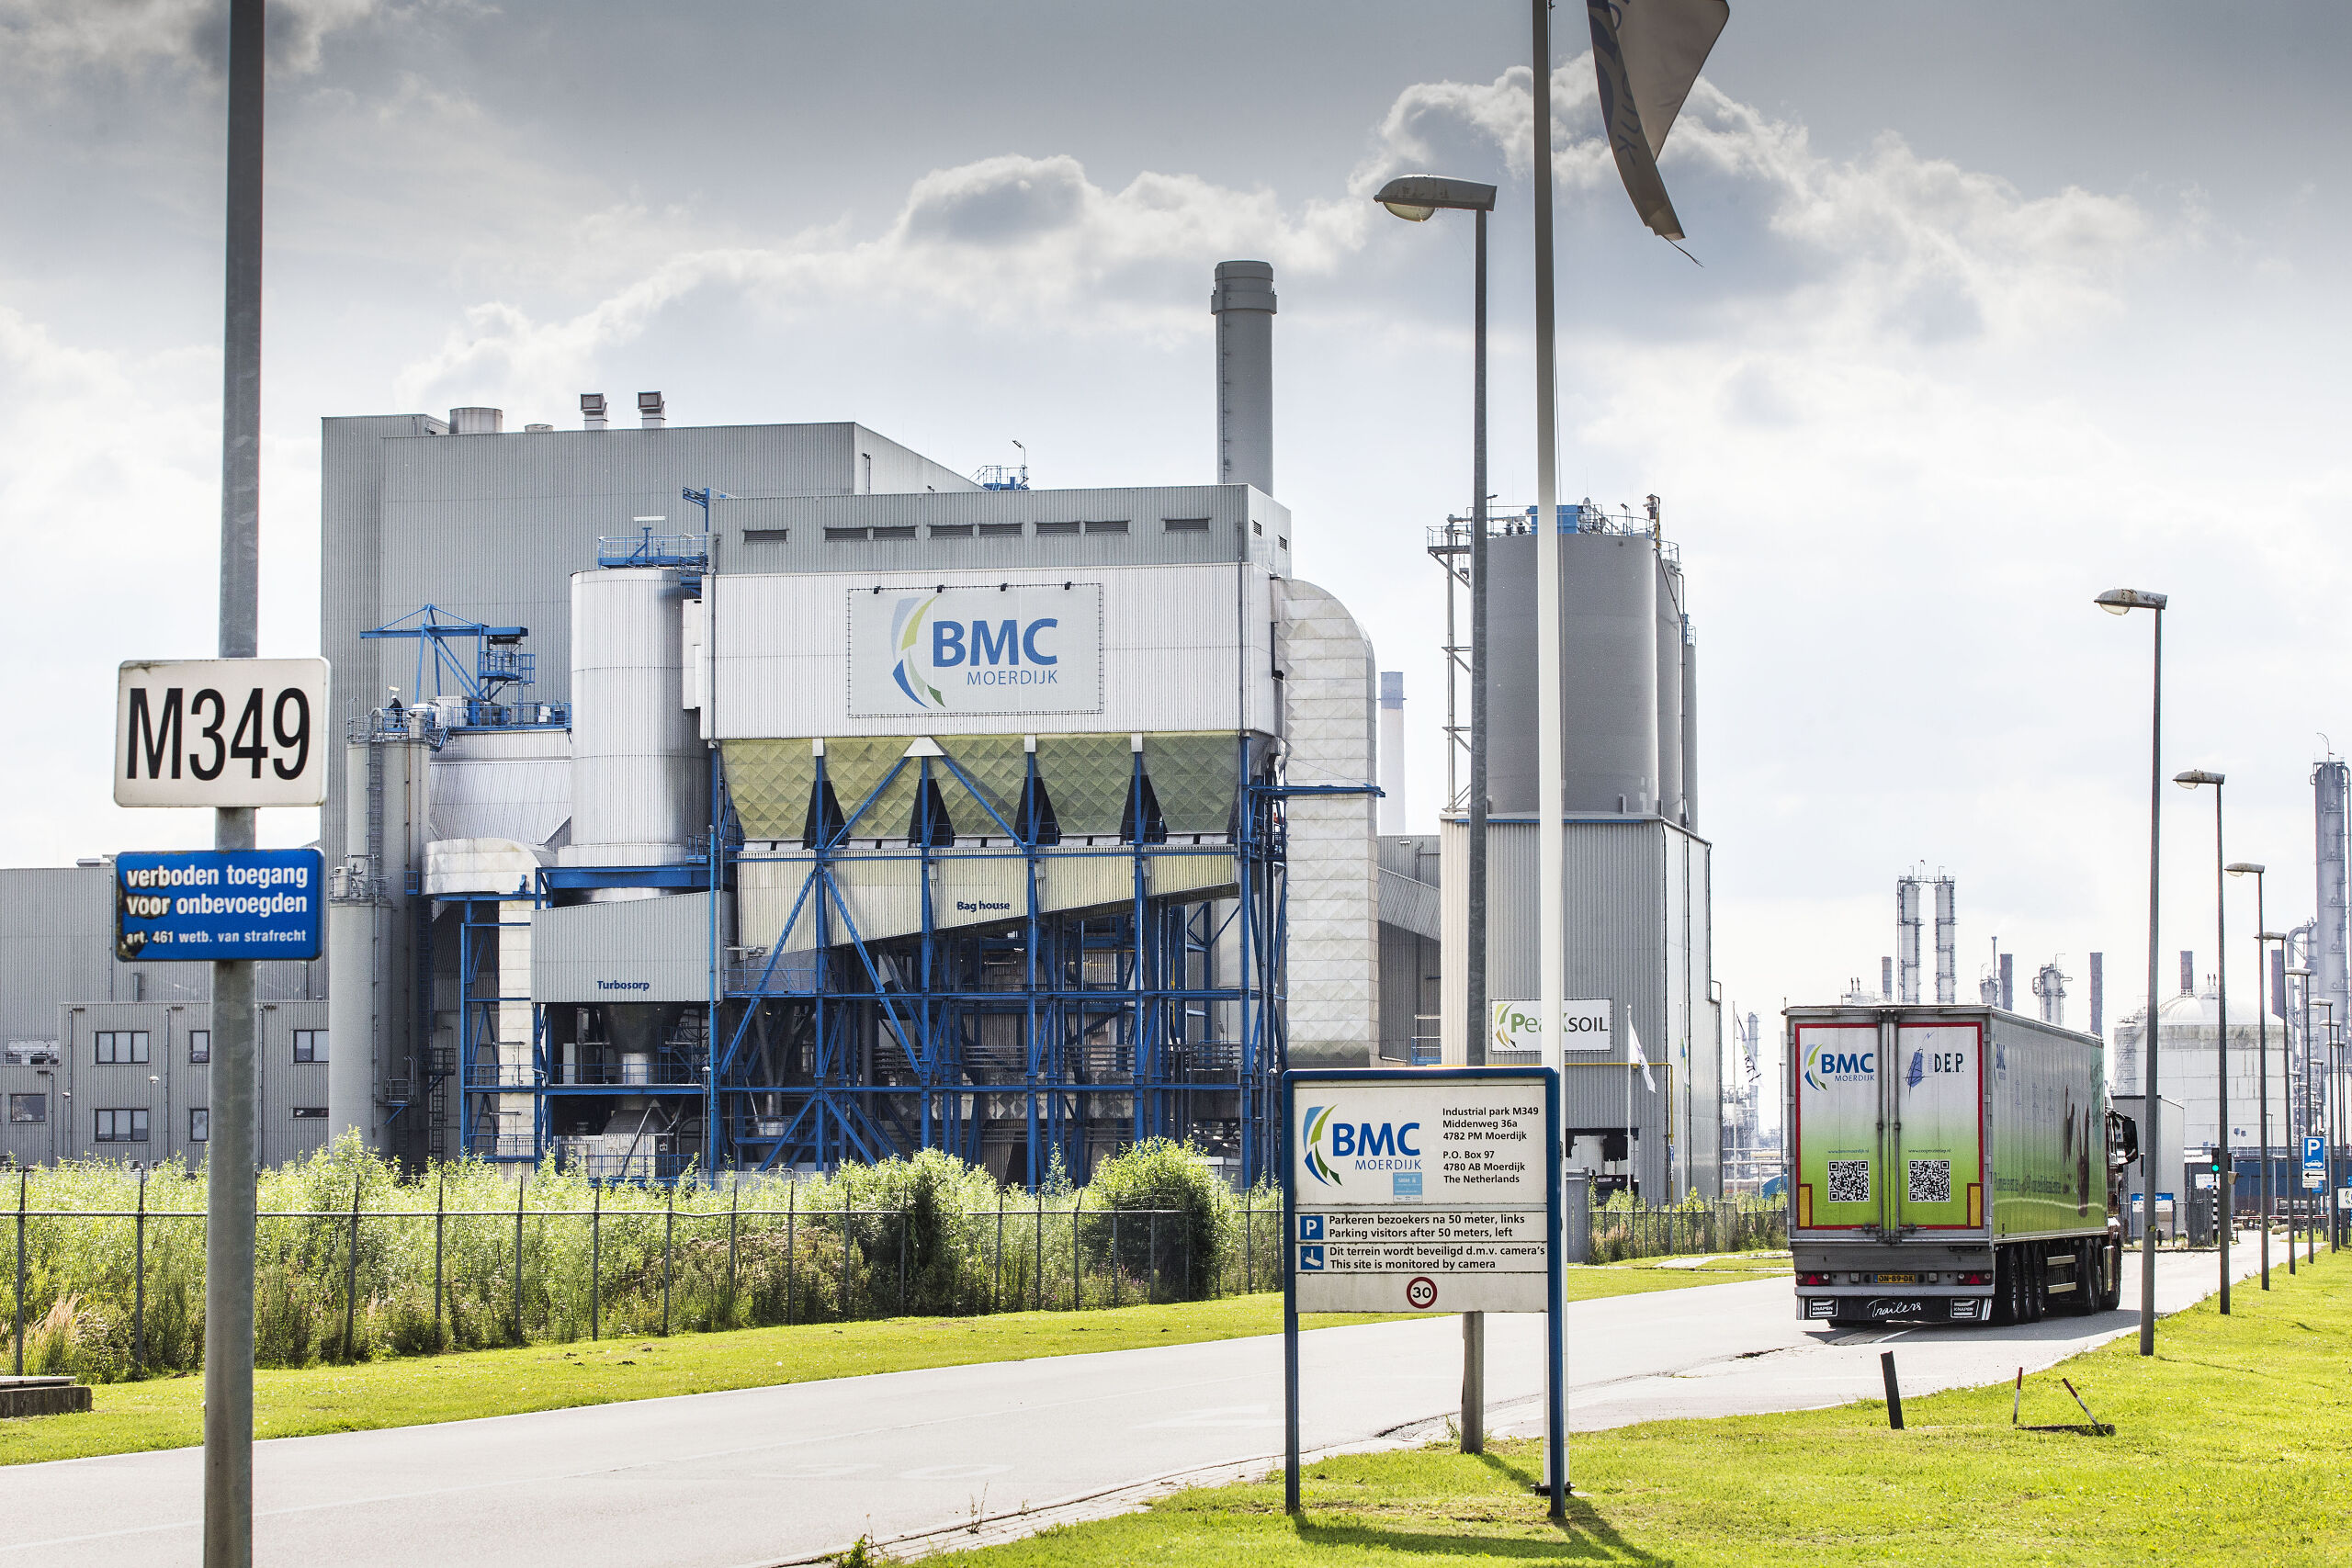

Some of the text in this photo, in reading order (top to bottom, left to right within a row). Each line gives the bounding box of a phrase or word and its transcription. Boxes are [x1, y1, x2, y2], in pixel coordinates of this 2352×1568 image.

[933, 617, 1058, 668] BMC
[967, 670, 1057, 685] MOERDIJK
[127, 687, 311, 782] M349
[127, 864, 309, 889] verboden toegang
[127, 892, 308, 918] voor onbevoegden
[956, 900, 1011, 913] Bag house
[126, 930, 307, 944] art. 461 wetb. van strafrecht
[596, 979, 650, 992] Turbosorp
[1821, 1053, 1874, 1073] BMC
[1934, 1053, 1964, 1073] D.E.P.
[1442, 1106, 1539, 1118] Industrial park M349
[1442, 1119, 1518, 1130] Middenweg 36a
[1332, 1122, 1421, 1157] BMC
[1442, 1131, 1528, 1142] 4782 PM Moerdijk
[2307, 1139, 2320, 1156] P
[1442, 1150, 1495, 1159] P.O. Box 97
[1354, 1159, 1422, 1170] MOERDIJK
[1443, 1162, 1526, 1173] 4780 AB Moerdijk
[1443, 1174, 1521, 1184] The Netherlands
[1329, 1214, 1525, 1225] Parkeren bezoekers na 50 meter, links
[1306, 1220, 1317, 1235] P
[1329, 1227, 1513, 1240] Parking visitors after 50 meters, left
[1329, 1247, 1345, 1257] Dit
[1346, 1247, 1381, 1256] terrein
[1383, 1246, 1414, 1256] wordt
[1417, 1246, 1464, 1258] beveiligd
[1465, 1246, 1498, 1256] d.m.v.
[1329, 1258, 1496, 1271] This site is monitored by camera
[1412, 1287, 1431, 1299] 30
[1866, 1298, 1922, 1318] Trailers
